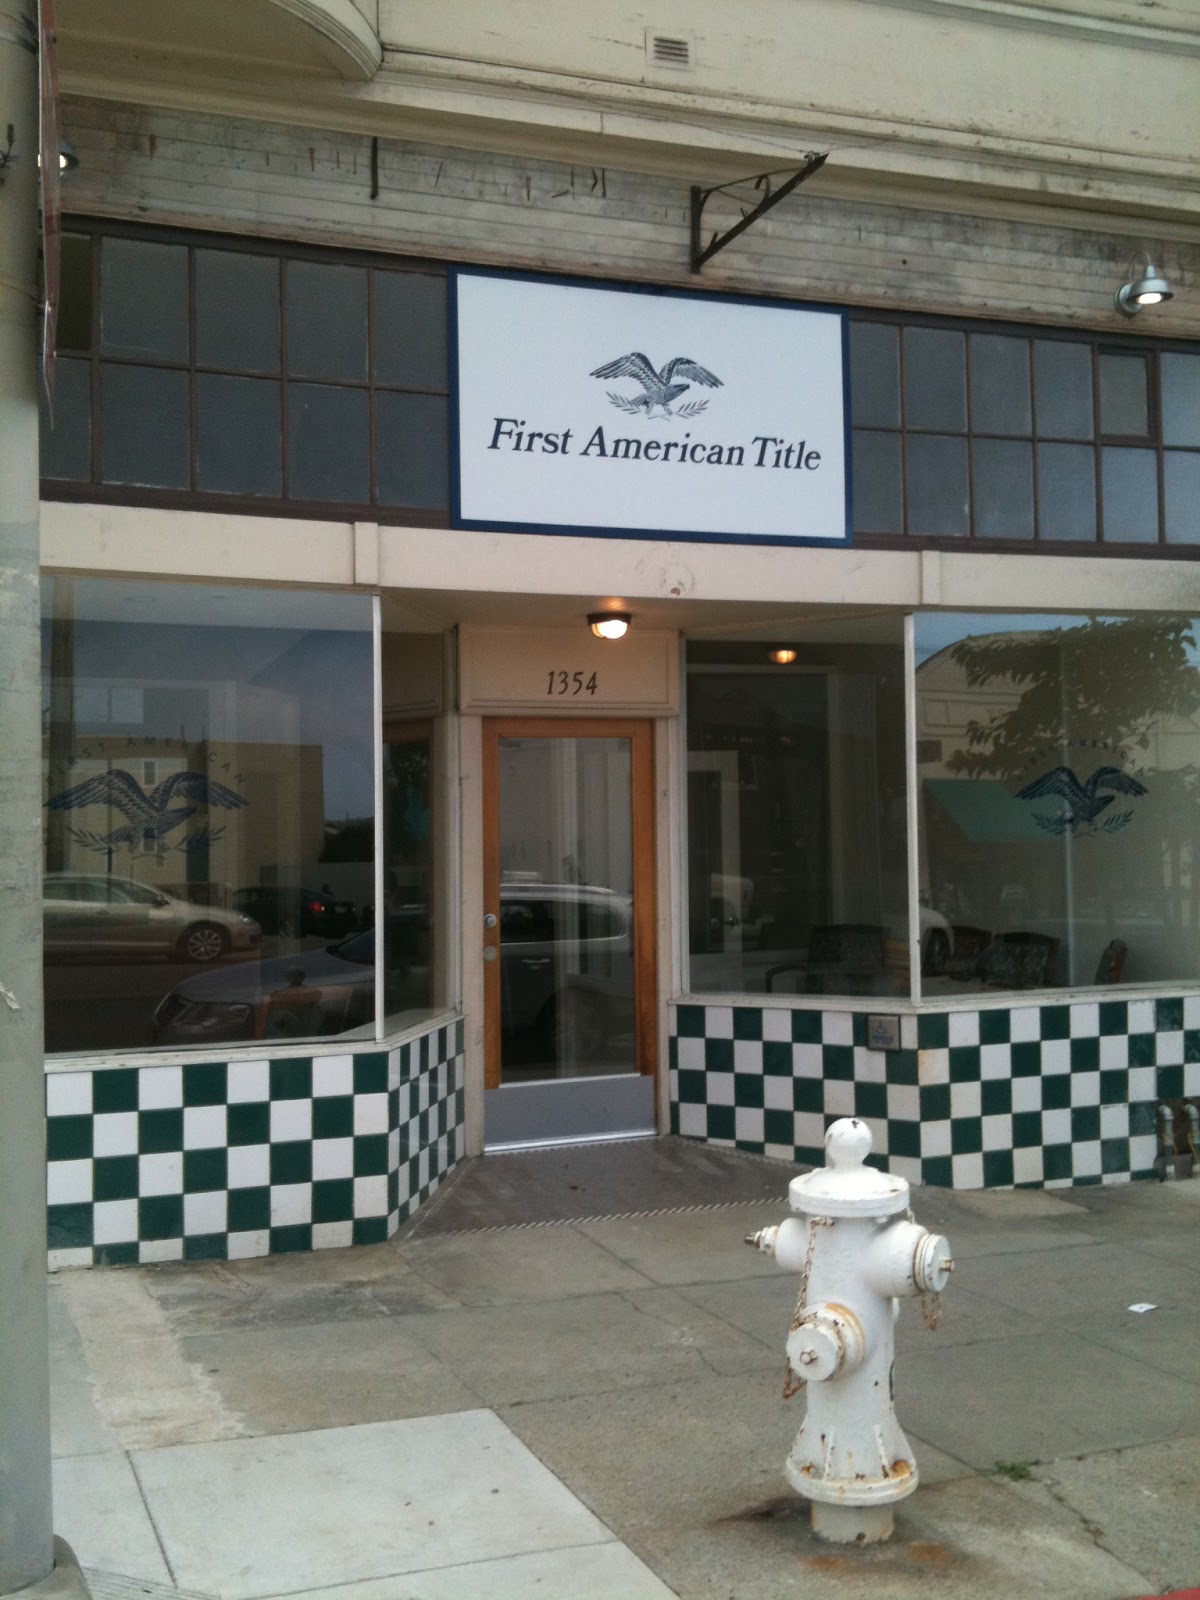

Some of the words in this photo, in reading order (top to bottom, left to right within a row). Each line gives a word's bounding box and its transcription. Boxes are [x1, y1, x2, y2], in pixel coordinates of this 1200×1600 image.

[487, 417, 573, 455] First
[579, 425, 745, 466] American
[751, 435, 822, 471] Title
[546, 670, 598, 696] 1354
[127, 736, 246, 784] AMERCAN
